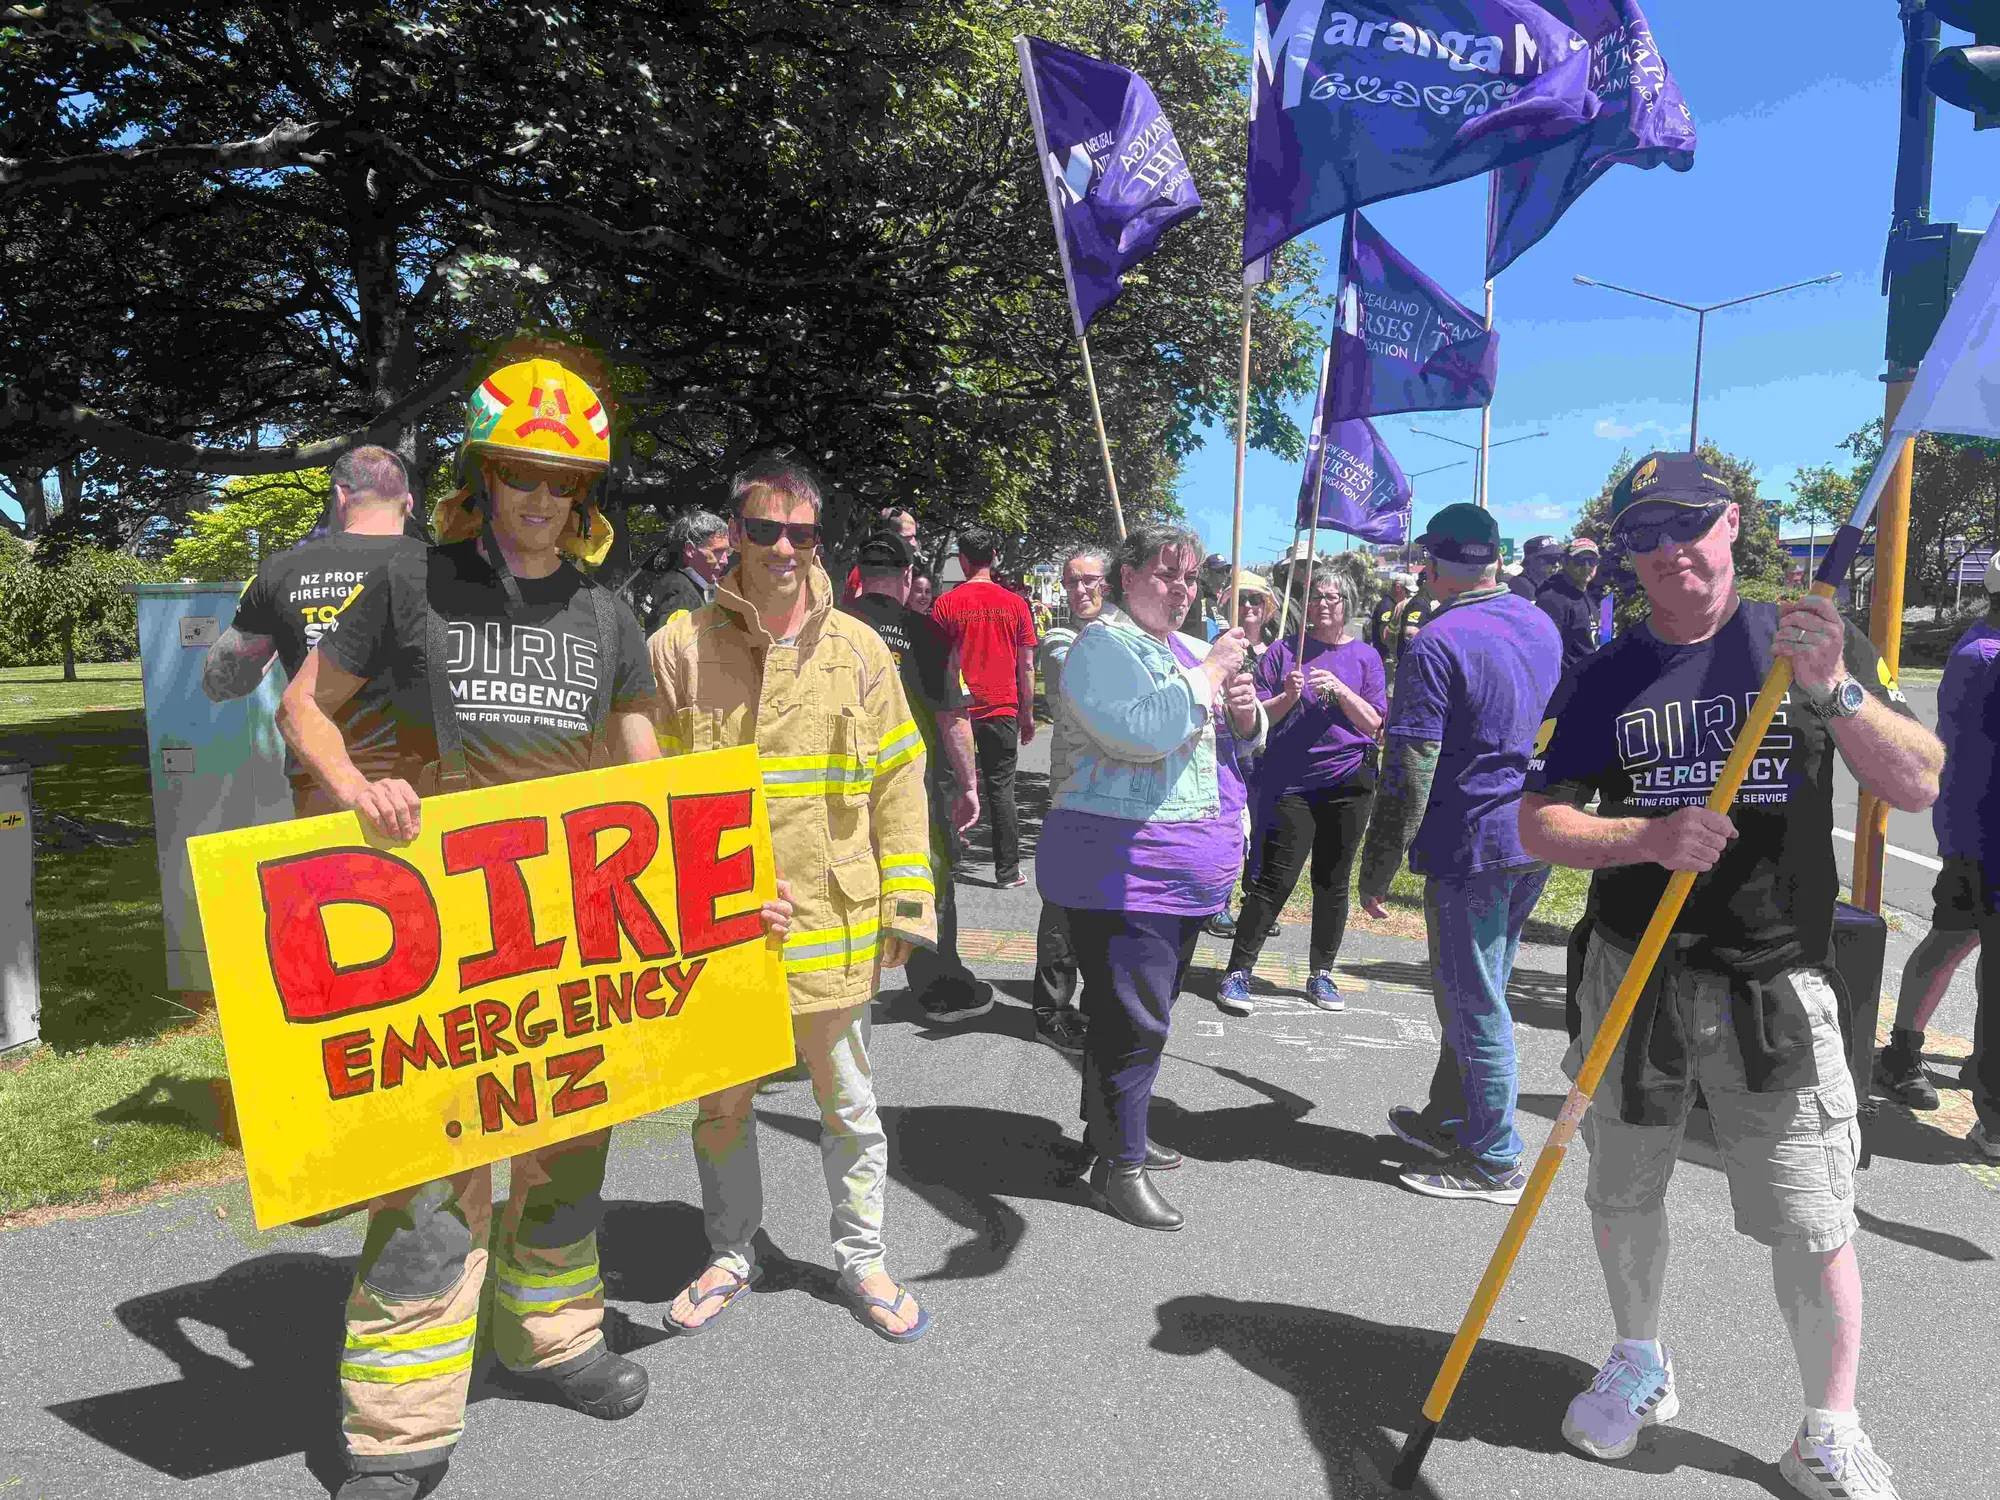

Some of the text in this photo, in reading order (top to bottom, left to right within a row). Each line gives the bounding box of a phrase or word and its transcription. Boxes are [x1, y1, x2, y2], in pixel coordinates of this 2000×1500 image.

[1362, 308, 1414, 342] RSES
[1323, 455, 1371, 492] URSES
[1325, 443, 1378, 480] EW ZEALAND
[289, 586, 354, 603] FIREFIGH
[300, 573, 320, 586] NZ
[446, 621, 599, 690] DIRE
[449, 679, 593, 713] MERGENCY
[454, 711, 477, 722] TING
[479, 712, 501, 724] FOR
[502, 713, 532, 725] YOUR
[533, 715, 556, 727] FIRE
[1615, 691, 1794, 770] DIRE
[1658, 796, 1681, 806] FOR
[1742, 792, 1788, 804] SERVICE
[256, 788, 768, 1025] DIRE
[321, 957, 708, 1102] EMERGENCY
